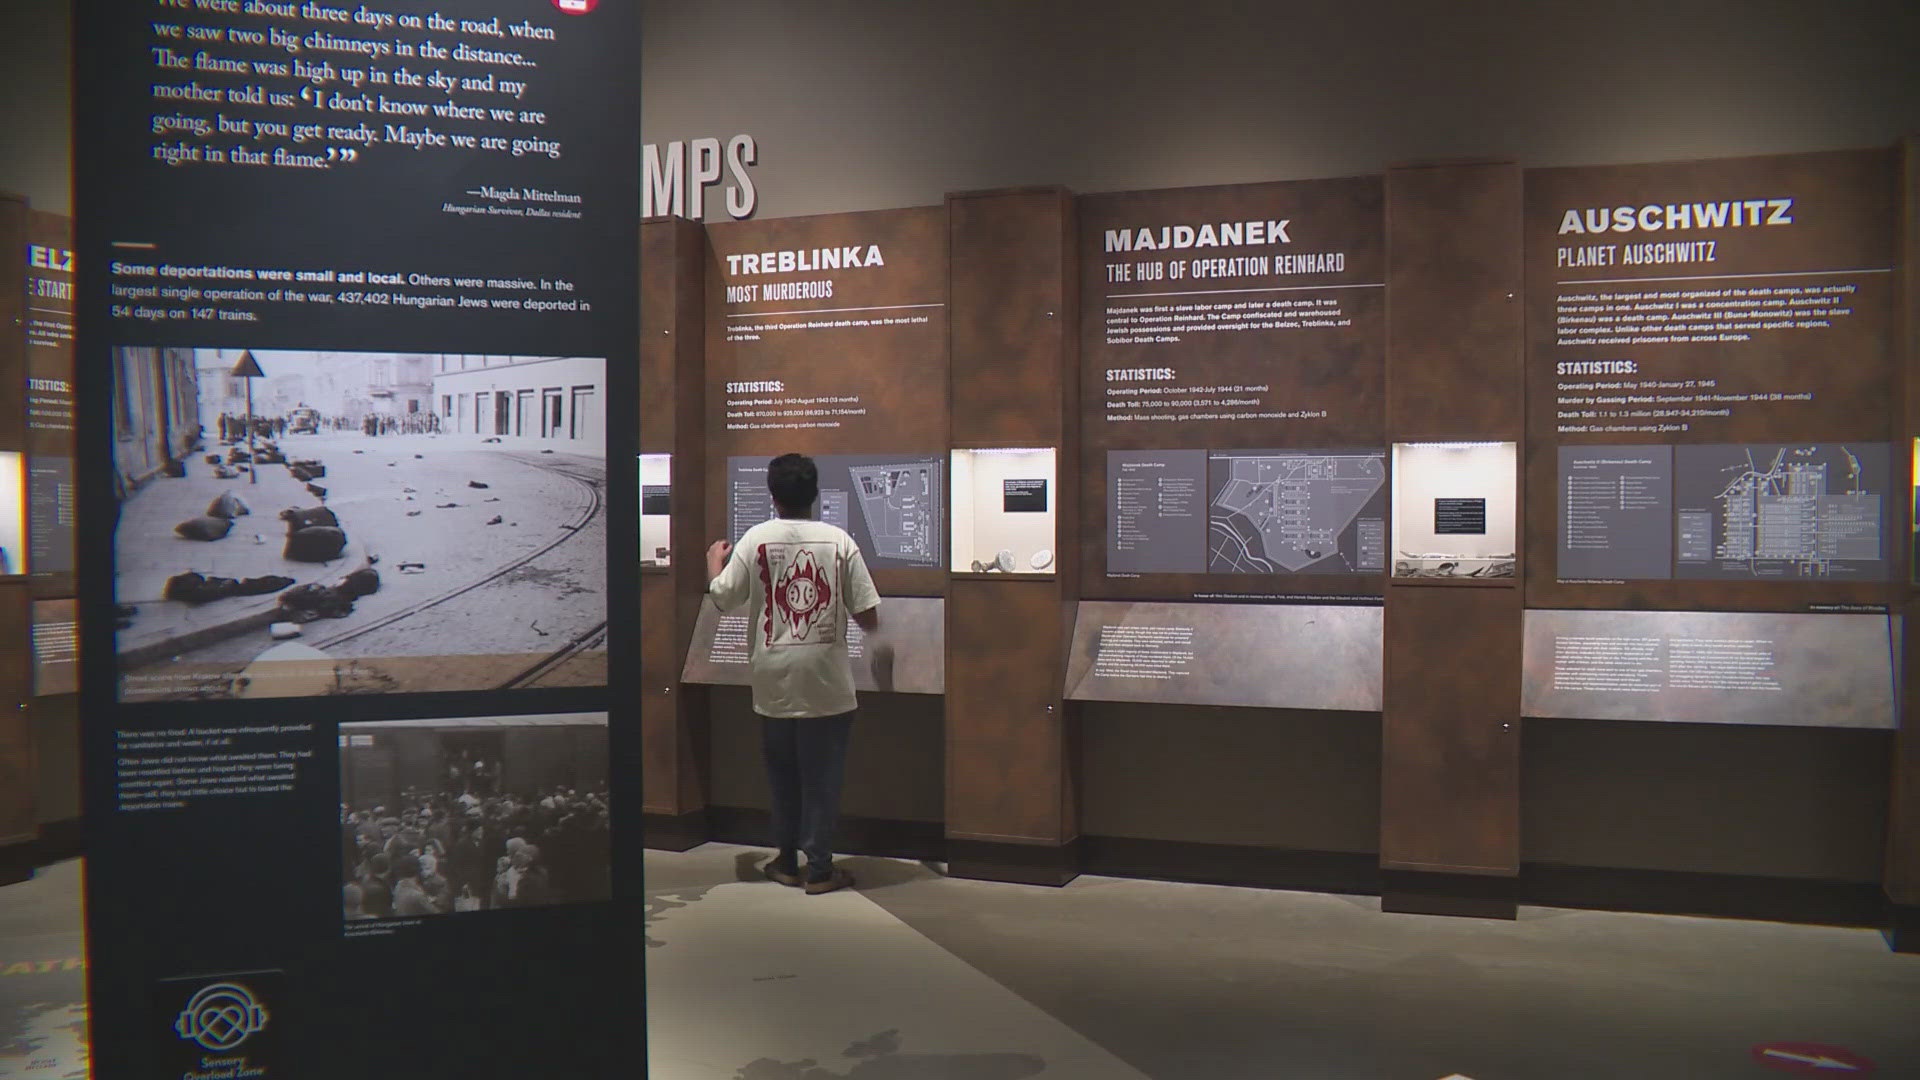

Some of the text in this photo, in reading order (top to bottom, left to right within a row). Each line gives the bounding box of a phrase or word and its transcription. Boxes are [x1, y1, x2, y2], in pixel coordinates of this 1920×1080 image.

[244, 1, 296, 17] about
[301, 5, 349, 22] three
[354, 9, 394, 30] days
[398, 15, 422, 28] on
[426, 15, 456, 31] the
[460, 20, 504, 37] road,
[508, 22, 554, 40] when
[155, 25, 178, 36] we
[187, 28, 220, 39] saw
[228, 29, 264, 43] two
[269, 29, 299, 52] big
[304, 33, 391, 59] chimneys
[396, 40, 414, 56] in
[418, 42, 448, 59] the
[154, 49, 526, 99] The flame was high up in the sky and my
[154, 86, 221, 101] mother
[228, 89, 264, 104] told
[269, 94, 294, 106] us:
[328, 95, 374, 112] don't
[379, 97, 428, 115] know
[432, 102, 484, 119] where
[489, 109, 514, 121] we
[520, 112, 545, 124] are
[153, 117, 560, 158] going, but you get ready. Maybe we are going
[153, 143, 199, 164] right
[204, 145, 224, 162] in
[230, 146, 268, 165] that
[642, 134, 756, 219] MPS
[523, 190, 581, 203] Mittelman
[442, 204, 486, 215] Hungarian
[525, 207, 551, 217] Dallas
[552, 210, 581, 218] resident
[1559, 199, 1792, 234] AUSCHWITZ
[1106, 220, 1290, 251] MAJDANEK
[727, 246, 884, 275] TREBLINKA
[1558, 241, 1715, 267] PLANET AUSCHWITZ
[112, 262, 573, 291] Some deportations were small and local. Others were massive. In the
[1107, 253, 1344, 282] THE HUB OF OPERATION REINHARD
[112, 286, 590, 312] largest single operation of the war, 437,402 Hungarian Jews were deported in
[728, 280, 832, 302] MOST MURDEROUS
[1614, 293, 1642, 301] largest
[1643, 292, 1658, 300] and
[1659, 291, 1680, 299] most
[1681, 290, 1721, 299] organized
[1722, 289, 1732, 297] of
[1733, 289, 1747, 297] the
[1748, 288, 1772, 296] death
[1773, 288, 1802, 296] camps,
[112, 305, 257, 321] 54 days on 147 trains.
[1106, 307, 1138, 315] Majdanek
[1272, 300, 1292, 308] death
[778, 322, 807, 331] Operation
[1107, 368, 1175, 380] STATISTICS:
[1558, 361, 1637, 374] STATISTICS:
[727, 381, 784, 392] STATISTICS:
[201, 1057, 245, 1071] Sensory
